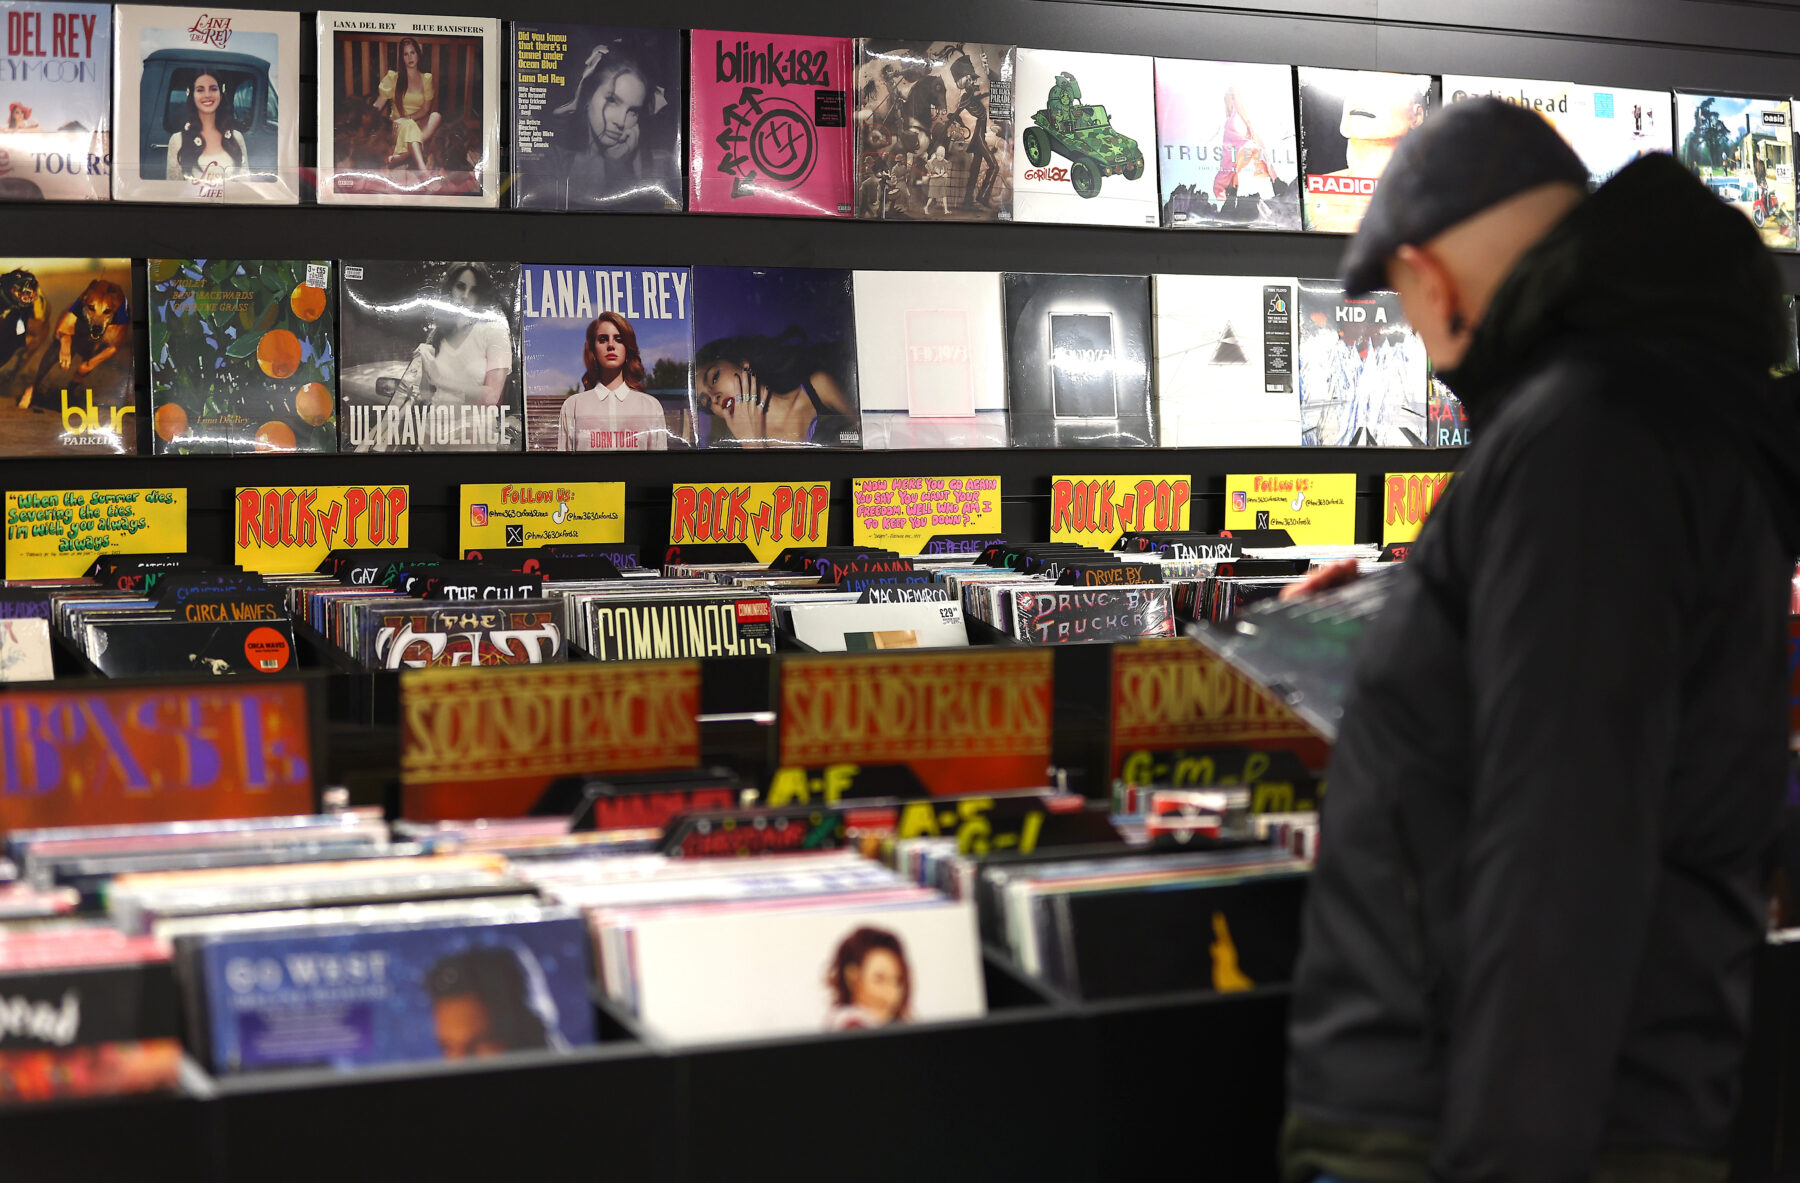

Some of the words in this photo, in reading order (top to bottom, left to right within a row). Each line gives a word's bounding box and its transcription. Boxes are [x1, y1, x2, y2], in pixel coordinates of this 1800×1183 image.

[188, 14, 232, 34] LANA
[333, 21, 357, 29] LANA
[437, 25, 484, 33] BANISTERS
[8, 11, 46, 57] DEL
[53, 13, 96, 58] REY
[203, 29, 233, 49] REY
[518, 32, 529, 40] Did
[547, 33, 567, 42] know
[518, 41, 533, 50] that
[518, 60, 539, 68] Ocean
[543, 52, 563, 60] under
[716, 40, 829, 87] blink-182
[518, 73, 535, 82] Lana
[537, 74, 548, 82] Del
[551, 74, 565, 86] Rey
[1764, 115, 1784, 123] oasis
[1308, 176, 1379, 194] RADIO
[525, 269, 592, 319] LANA
[595, 270, 640, 319] DEL
[643, 271, 688, 320] REY
[1335, 306, 1367, 323] KID
[1374, 306, 1387, 323] A
[61, 389, 136, 436] blur
[349, 404, 511, 445] ULTRAVIOLENCE
[63, 437, 122, 446] PARKLIE
[590, 431, 612, 448] BORN
[614, 431, 625, 448] TO
[626, 431, 638, 448] DIE
[892, 478, 923, 490] HERE
[925, 478, 944, 490] YOU
[949, 479, 963, 490] GO
[965, 479, 997, 490] AGAIN
[64, 492, 85, 506] the
[90, 491, 140, 505] Summer
[854, 492, 872, 504] YOU
[874, 492, 894, 504] SAY
[898, 491, 918, 504] YOU
[921, 491, 950, 501] WANT
[954, 491, 979, 503] YOUR
[8, 508, 73, 525] Severing
[79, 505, 100, 519] the
[672, 486, 750, 543] ROCK
[772, 485, 828, 542] POP
[906, 503, 933, 516] WELL
[937, 503, 959, 513] WHO
[962, 502, 980, 514] AM
[982, 501, 992, 512] I
[1051, 480, 1115, 534] ROCK
[1135, 480, 1190, 532] POP
[236, 488, 317, 549] ROCK
[344, 487, 407, 548] POP
[864, 518, 878, 529] TO
[882, 517, 906, 529] KEEP
[909, 517, 927, 529] YOU
[67, 520, 95, 539] you
[929, 539, 980, 554] DEPECHE
[1201, 543, 1233, 559] DURY
[1085, 568, 1123, 586] DRIVE
[1126, 566, 1143, 581] BY
[443, 585, 477, 600] THE
[868, 587, 892, 604] MAC
[897, 587, 948, 603] DEMARCO
[186, 603, 229, 622] CIRCA
[231, 602, 277, 621] WAVES
[439, 613, 496, 629] THE
[1034, 614, 1158, 642] TRUCKER
[598, 604, 772, 661] COMMUNAR
[797, 676, 1048, 745] SOUNDTRACKS
[405, 690, 697, 764] SOUNDTRACKS
[225, 956, 283, 993] GO
